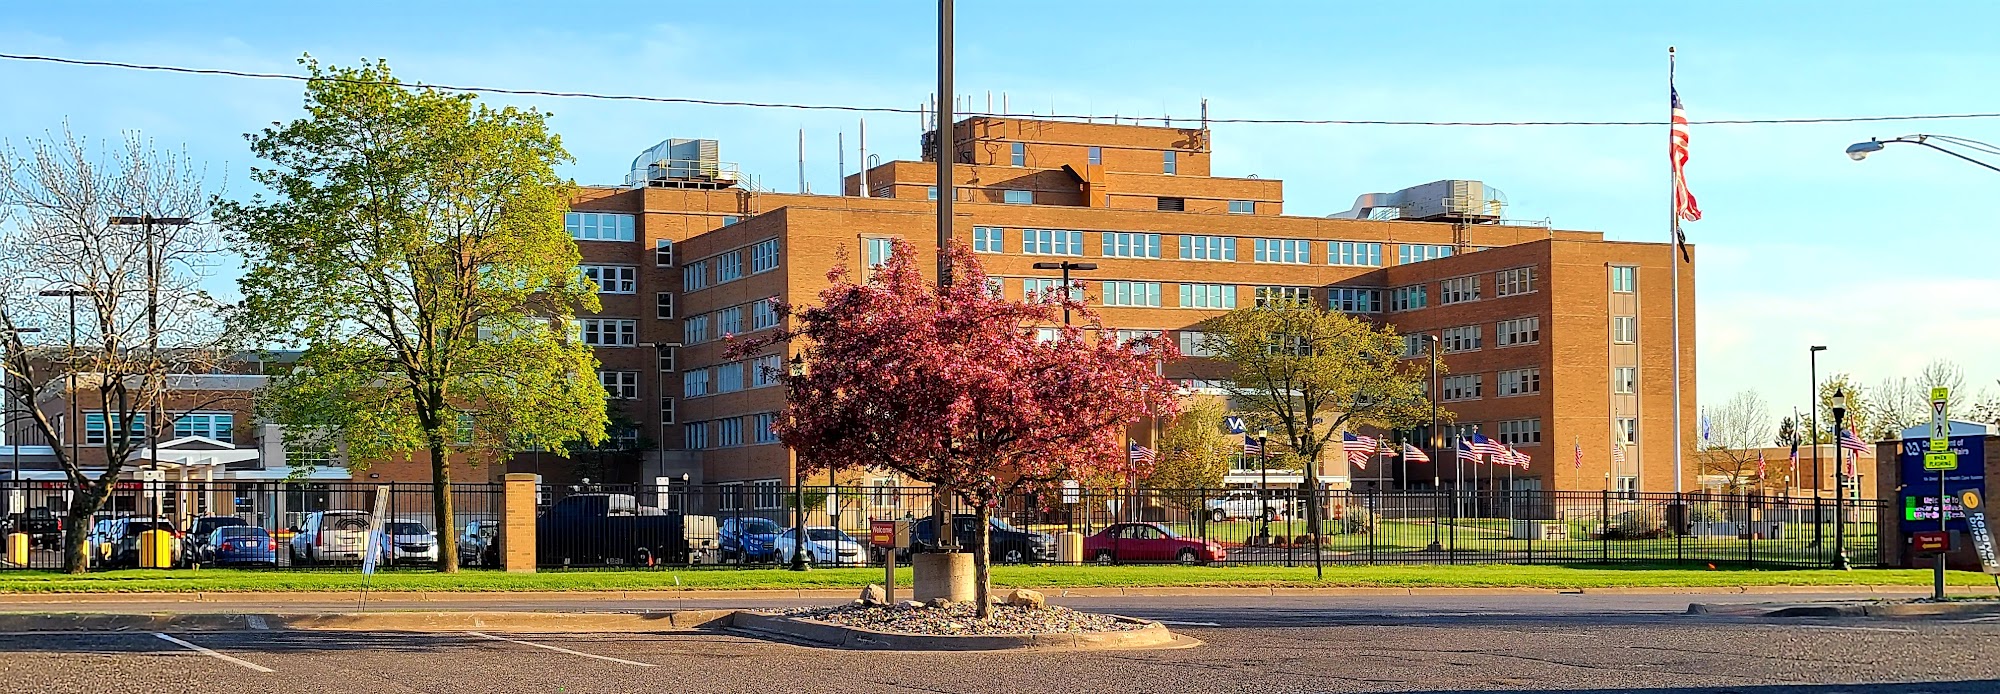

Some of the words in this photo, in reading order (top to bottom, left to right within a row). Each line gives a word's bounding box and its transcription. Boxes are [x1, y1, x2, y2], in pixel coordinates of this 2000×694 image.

[1227, 417, 1248, 431] VA
[872, 525, 893, 534] Welcome
[1969, 516, 1981, 542] Drive
[1978, 544, 1990, 567] Thru
[1974, 512, 1999, 568] Reserved
